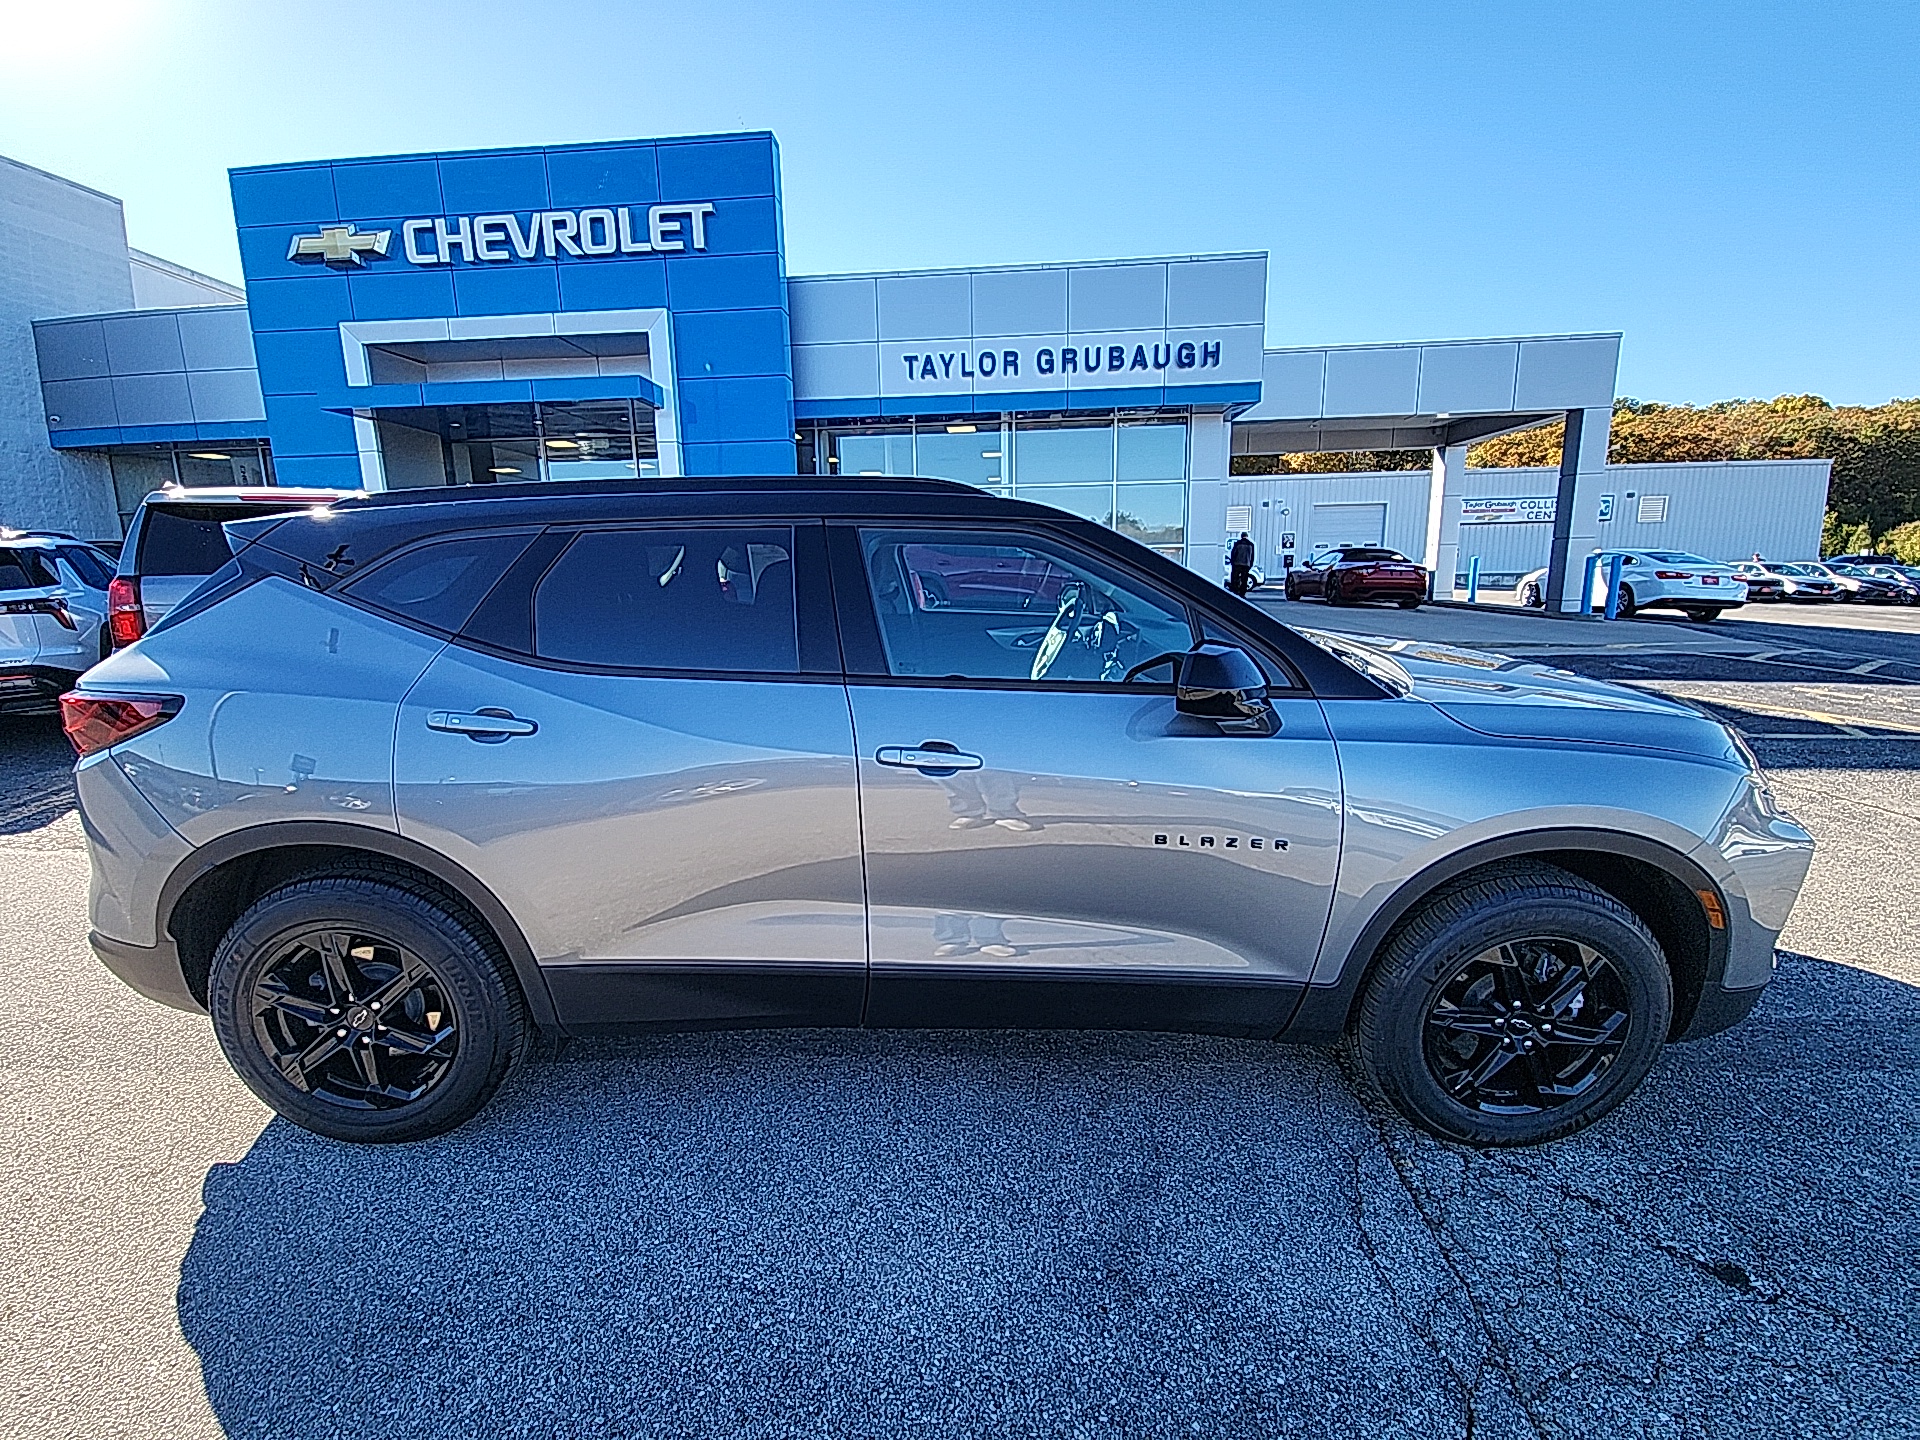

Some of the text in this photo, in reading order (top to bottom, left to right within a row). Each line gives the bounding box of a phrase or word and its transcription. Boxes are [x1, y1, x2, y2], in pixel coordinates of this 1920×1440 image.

[402, 203, 717, 265] CHEVROLET
[903, 340, 1222, 380] TAYLOR GRUBAUGH
[1154, 834, 1289, 851] BLAZER
